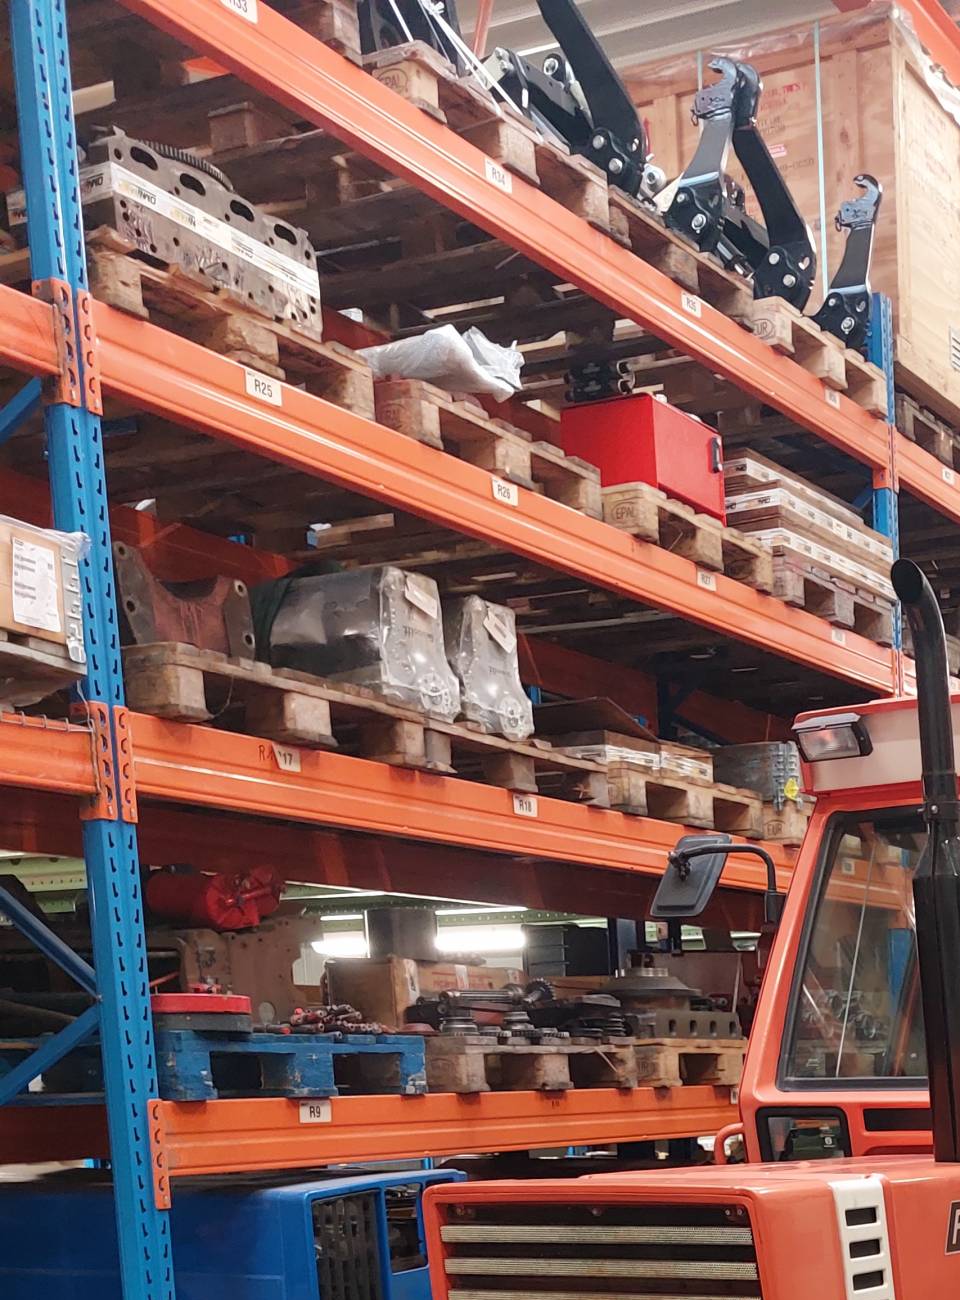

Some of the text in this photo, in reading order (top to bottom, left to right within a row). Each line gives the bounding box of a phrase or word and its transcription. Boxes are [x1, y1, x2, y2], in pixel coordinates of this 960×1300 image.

[254, 379, 273, 398] R25
[497, 484, 511, 500] R26
[310, 1105, 321, 1118] R9
